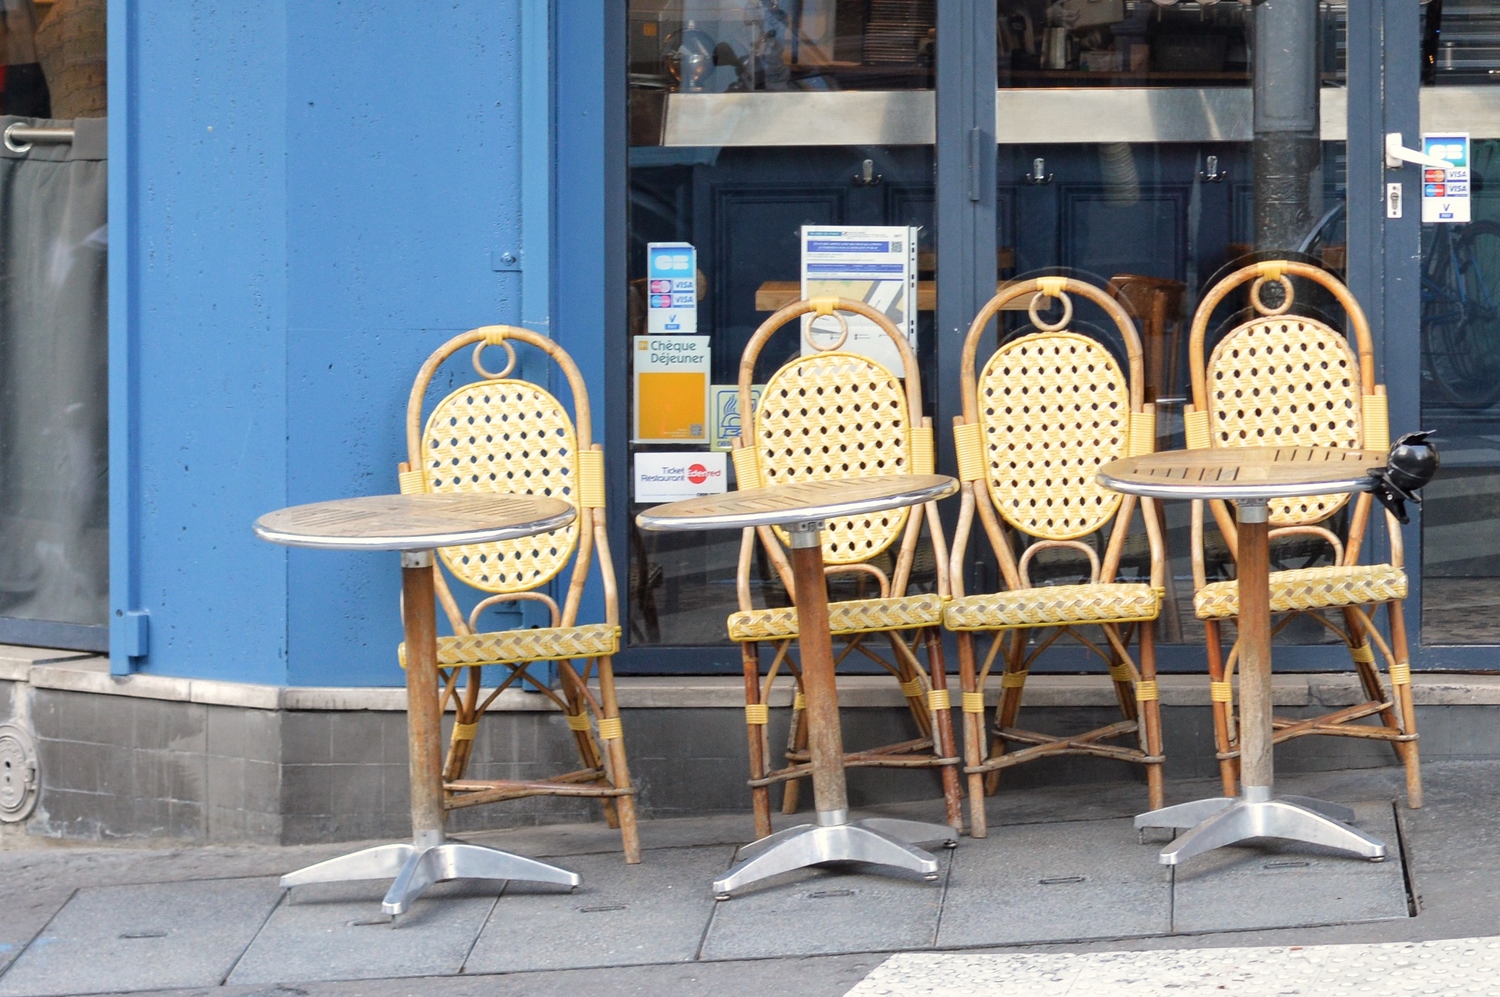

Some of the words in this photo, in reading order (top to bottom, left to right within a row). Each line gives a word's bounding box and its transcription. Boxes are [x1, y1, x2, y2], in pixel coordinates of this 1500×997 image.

[1449, 170, 1467, 178] VISA
[654, 254, 689, 270] CB
[675, 281, 693, 289] VISA
[650, 339, 697, 353] Chèque
[650, 352, 705, 366] Déjeuner
[661, 466, 685, 475] Ticket
[641, 474, 685, 482] Restaurant
